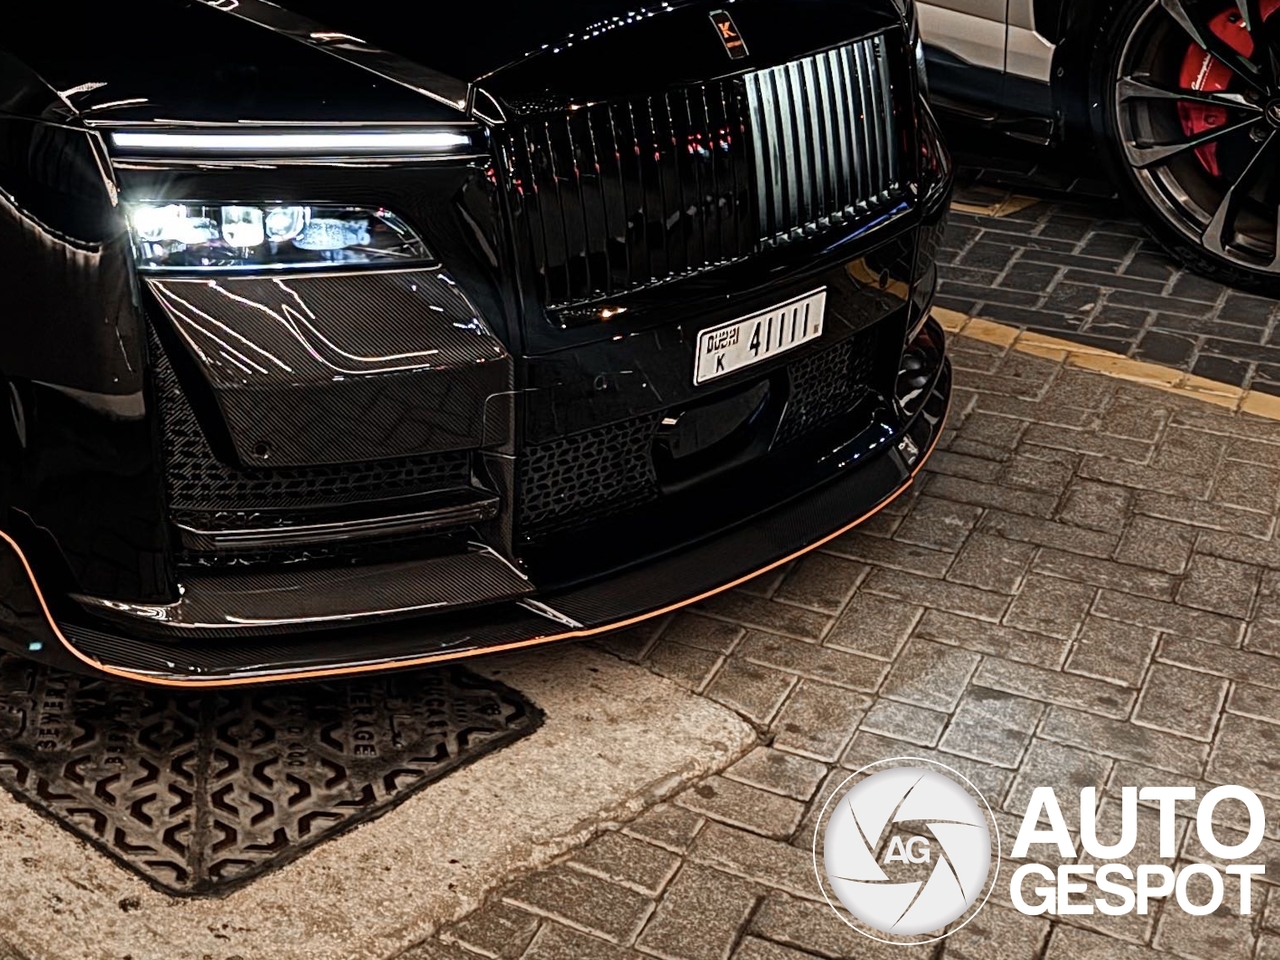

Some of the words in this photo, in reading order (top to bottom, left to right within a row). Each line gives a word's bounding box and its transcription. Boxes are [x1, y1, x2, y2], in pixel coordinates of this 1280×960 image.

[717, 21, 737, 39] K
[749, 303, 810, 357] 41111
[715, 353, 725, 373] K
